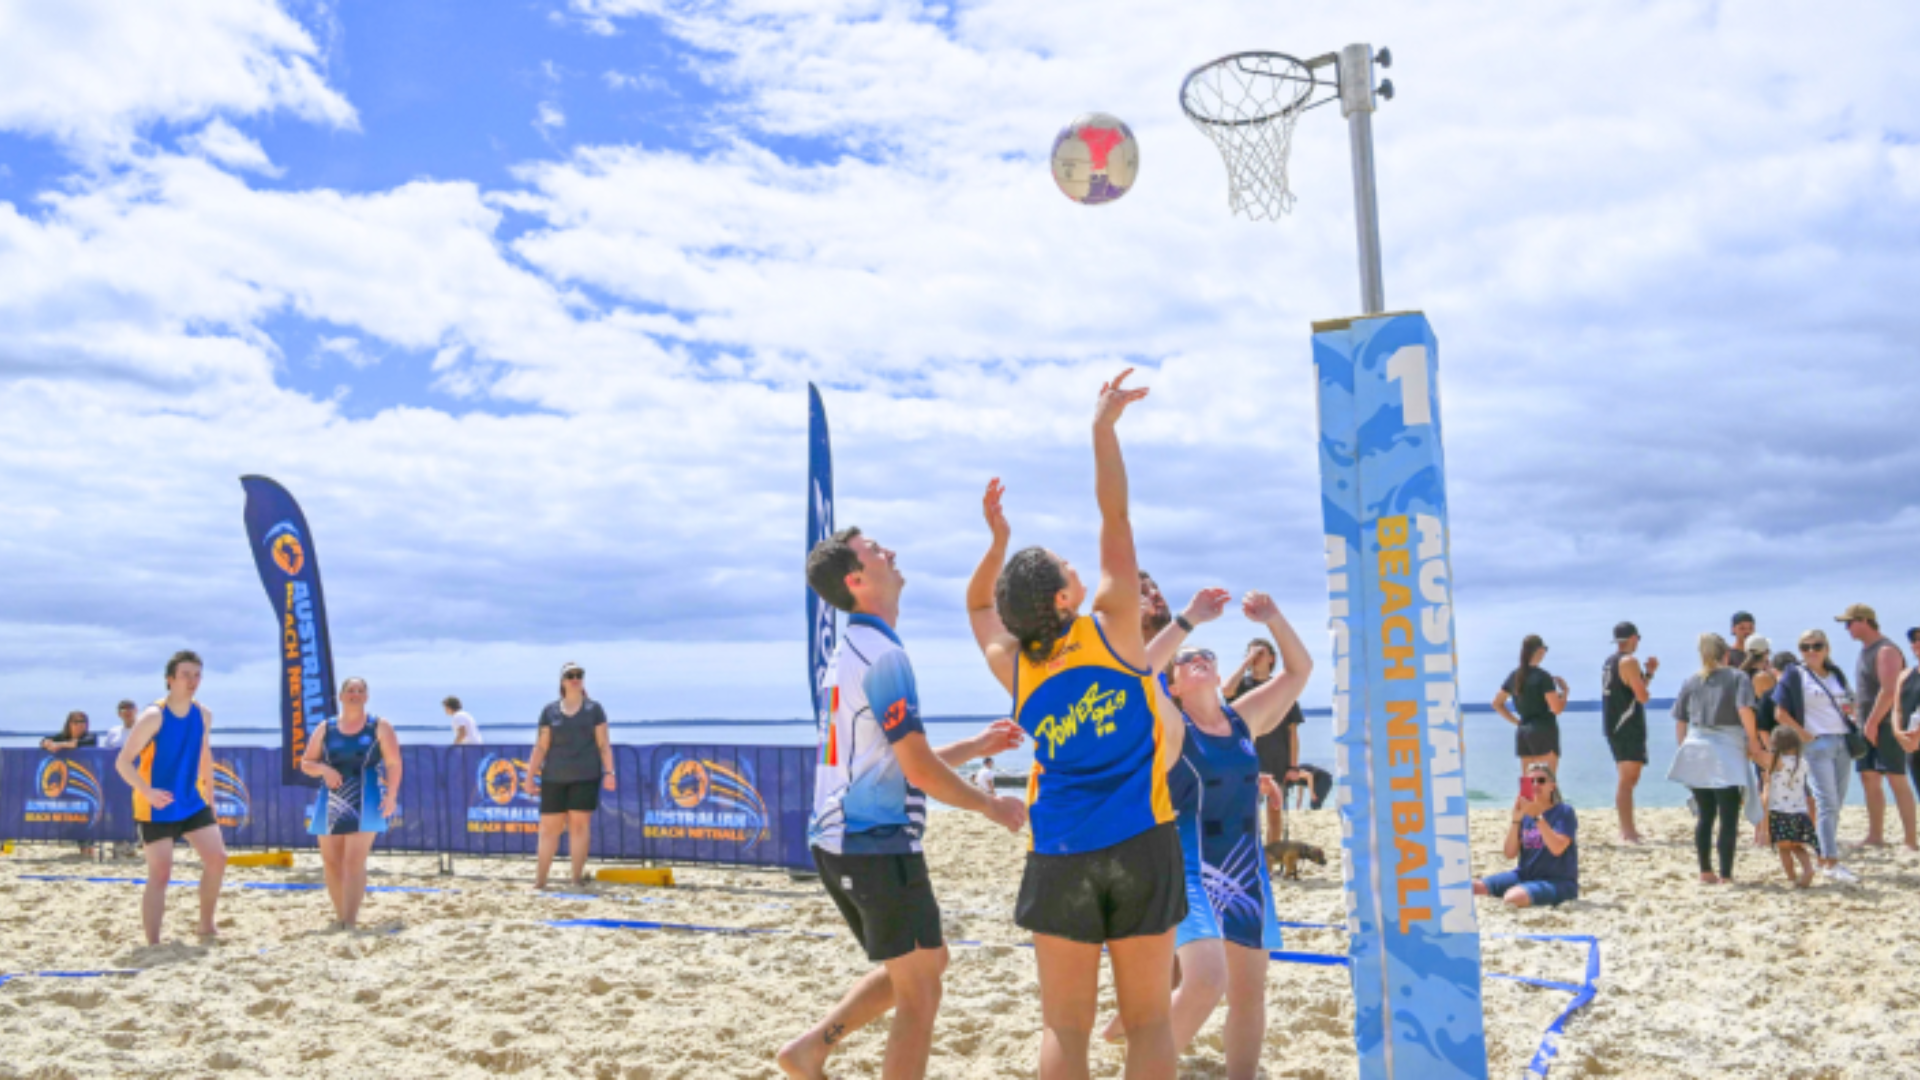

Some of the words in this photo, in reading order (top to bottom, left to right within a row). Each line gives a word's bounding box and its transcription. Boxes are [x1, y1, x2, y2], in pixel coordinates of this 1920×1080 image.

[1386, 344, 1431, 425] 1
[1376, 514, 1416, 680] BEACH
[293, 580, 327, 736] AUSTRALI
[643, 826, 686, 838] BEACH
[687, 828, 746, 841] NETBALL
[644, 808, 747, 828] AUSTRALIAN
[1385, 699, 1432, 934] NETBALL
